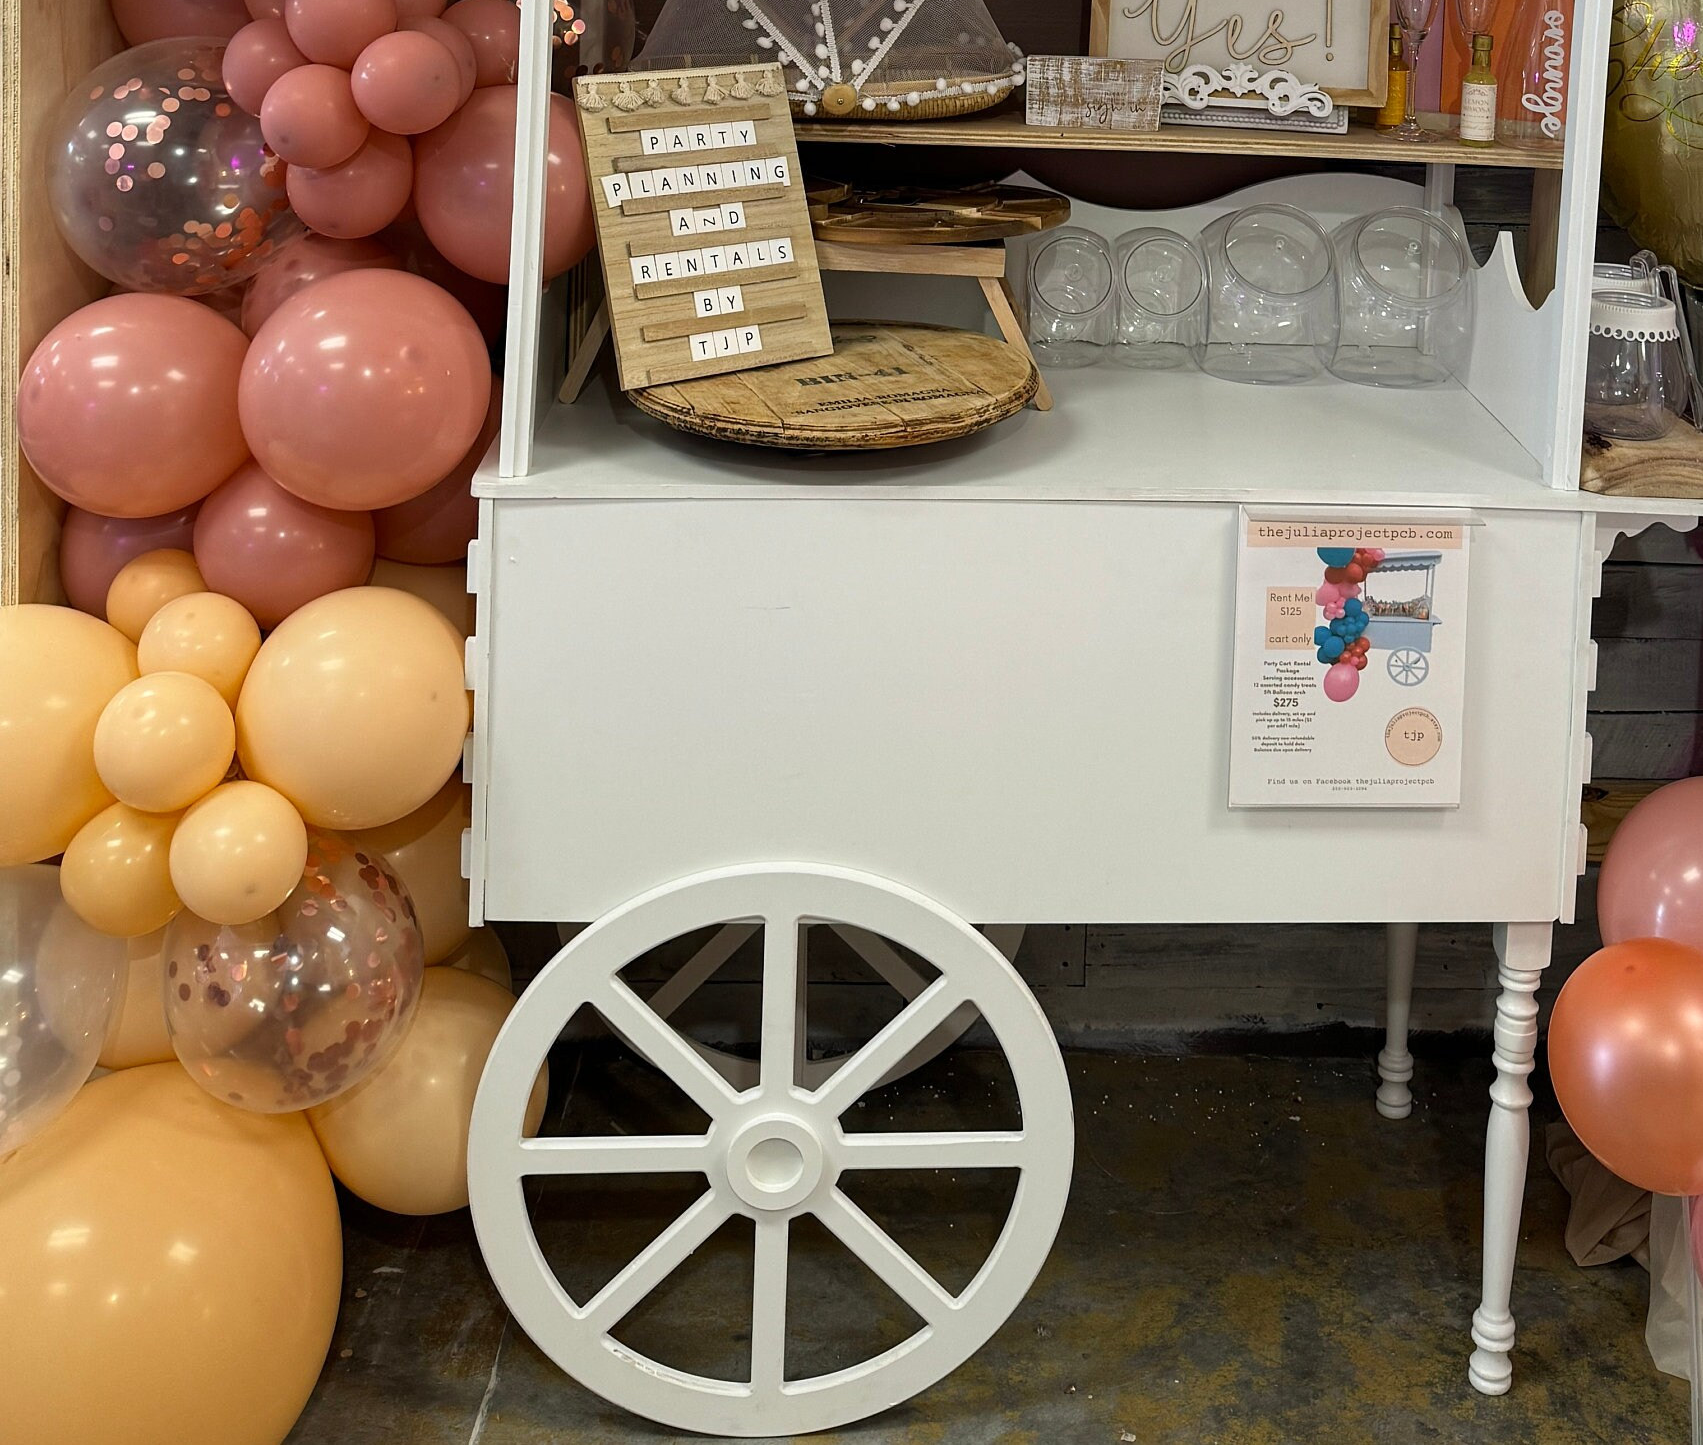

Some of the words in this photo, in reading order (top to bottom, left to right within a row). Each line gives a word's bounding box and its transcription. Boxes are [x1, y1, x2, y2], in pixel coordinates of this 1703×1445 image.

[1522, 9, 1564, 138] orange
[1085, 102, 1123, 124] sign
[1129, 103, 1147, 114] in
[650, 128, 750, 151] PARTY
[612, 165, 785, 197] PLANNING
[678, 210, 740, 231] AND
[641, 245, 788, 280] RENTALS
[703, 295, 736, 312] BY
[698, 331, 755, 356] TJP
[908, 389, 985, 404] ROMAGNA
[1258, 526, 1454, 541] thejuliaprojectpcb.com
[1270, 592, 1292, 602] Rent
[1294, 592, 1313, 602] Me!
[1269, 634, 1289, 643] cart
[1291, 632, 1312, 646] only
[1273, 697, 1299, 708] $275
[1403, 729, 1425, 742] tjp
[1355, 778, 1435, 786] thejuliaprojectpcb
